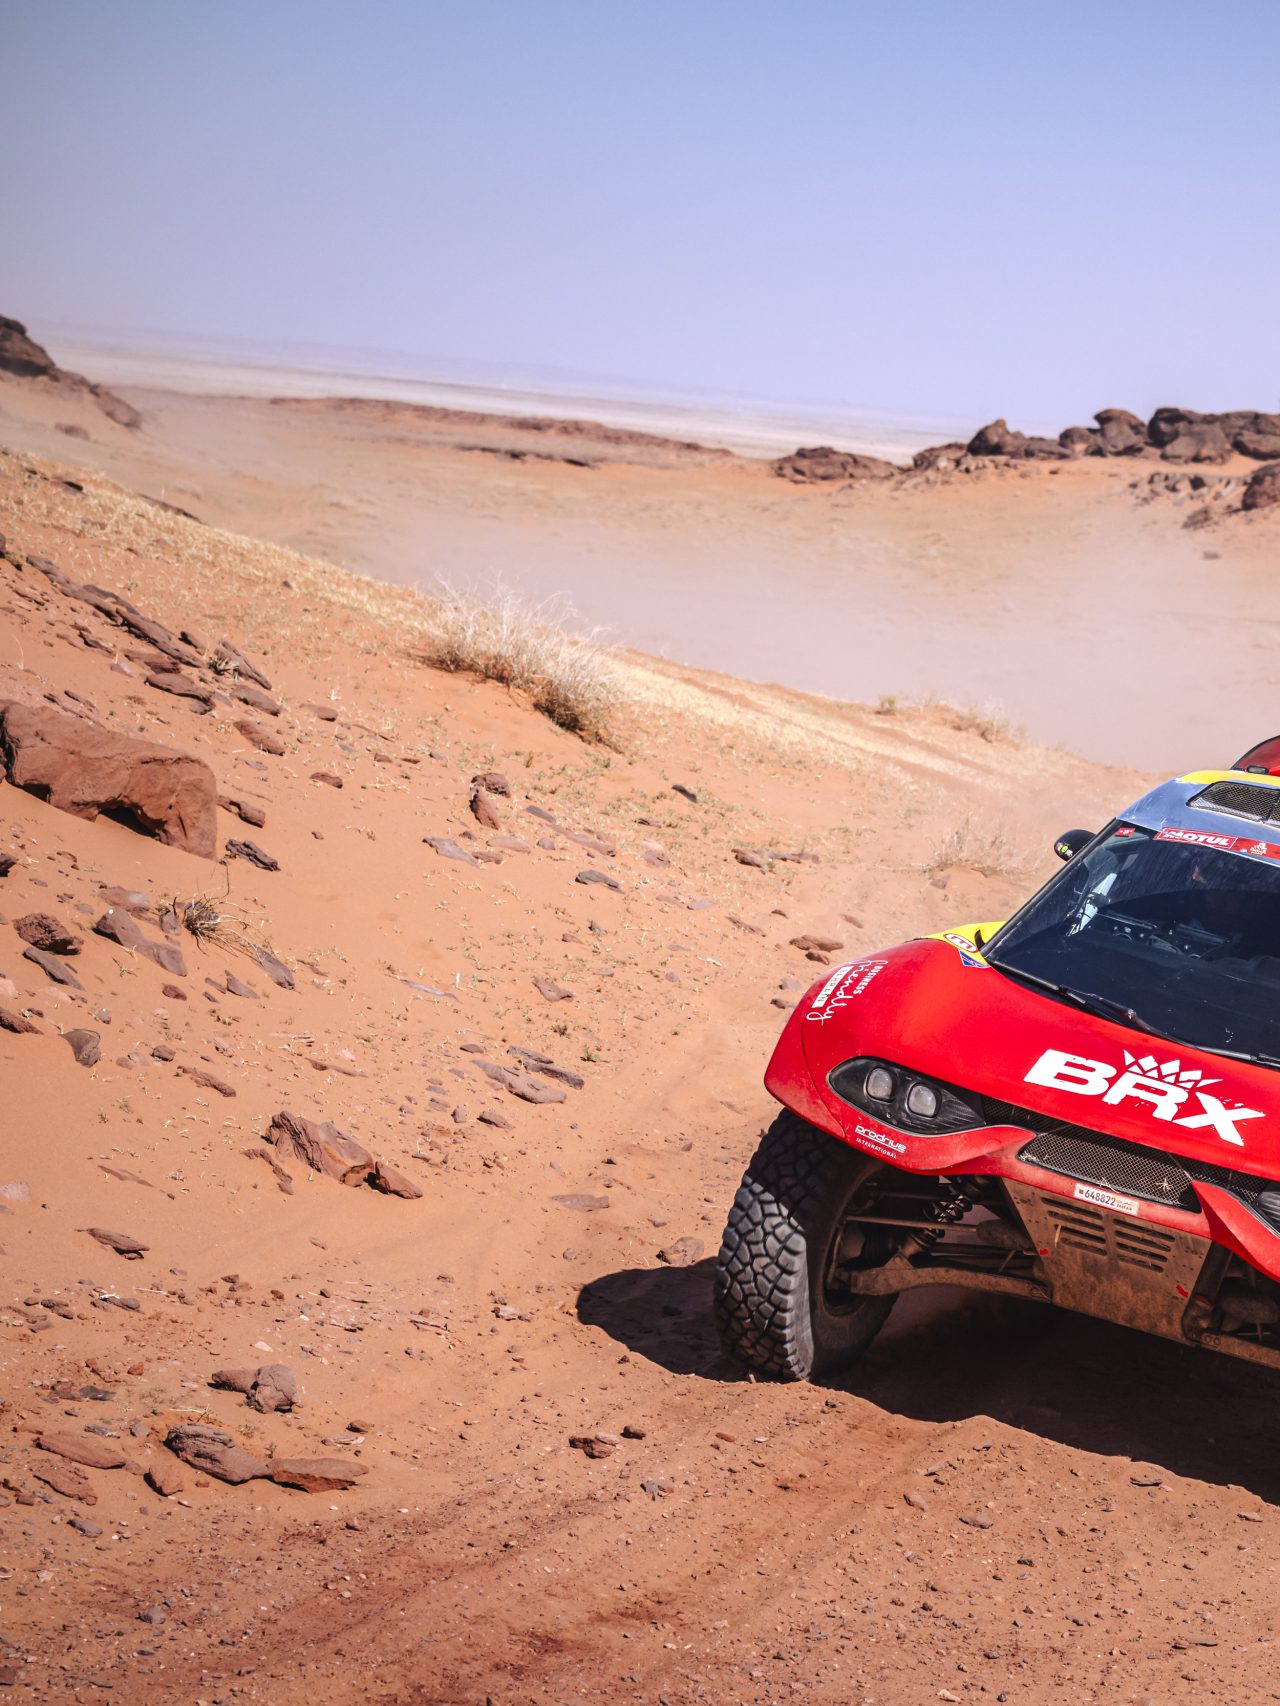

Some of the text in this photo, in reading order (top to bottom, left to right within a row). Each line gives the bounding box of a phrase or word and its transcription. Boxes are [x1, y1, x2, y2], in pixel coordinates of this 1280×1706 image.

[1163, 831, 1230, 846] MOTUL
[1023, 1048, 1267, 1147] BRX
[854, 1124, 907, 1154] prodrive
[856, 1137, 898, 1160] INTERNATIONAL
[1084, 1189, 1117, 1207] 648822
